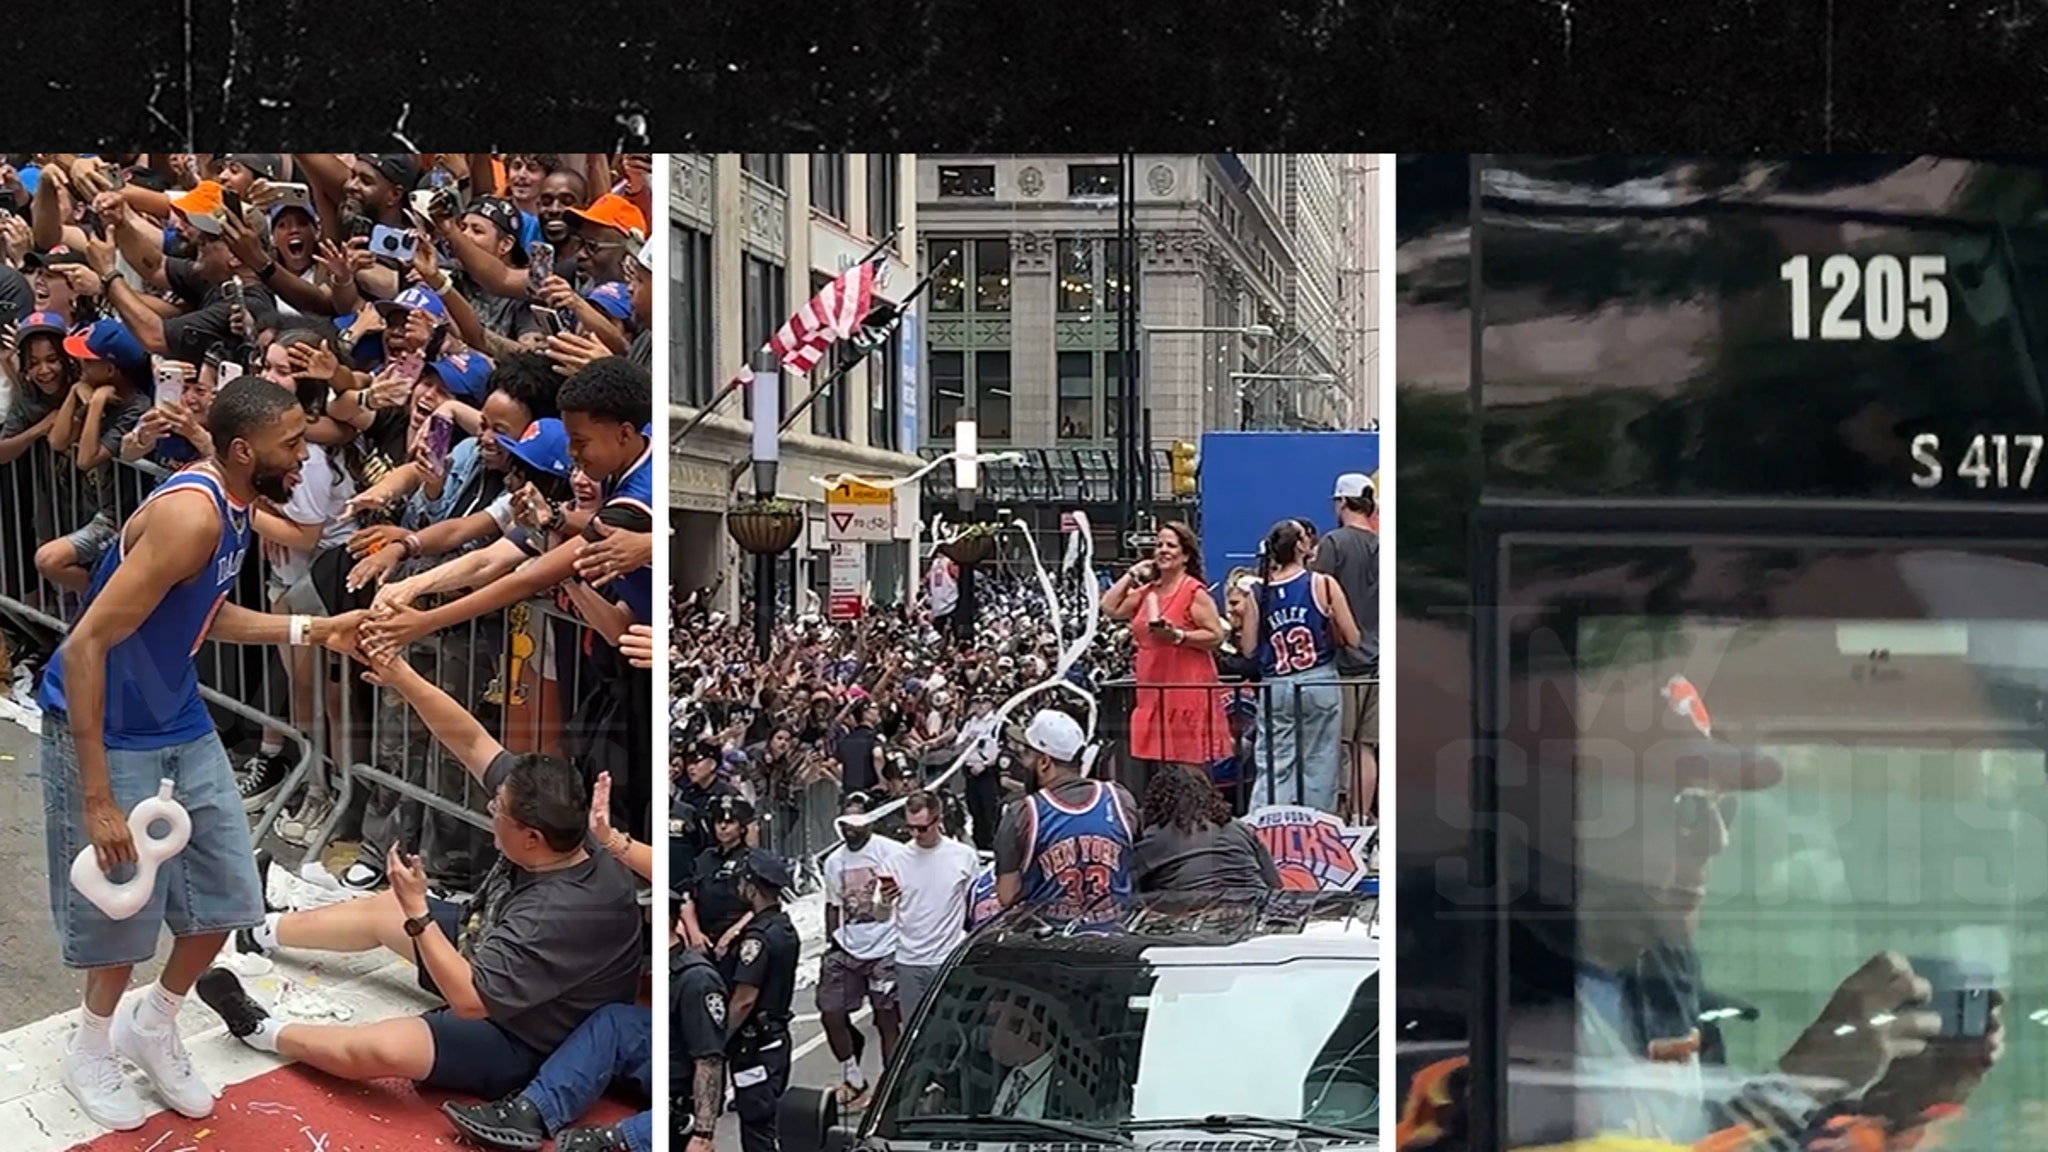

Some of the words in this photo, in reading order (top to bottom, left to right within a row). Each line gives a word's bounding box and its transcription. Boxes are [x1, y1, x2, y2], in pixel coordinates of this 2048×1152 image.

[1780, 254, 1948, 340] 1205
[1911, 433, 1943, 488] S
[1957, 434, 2044, 489] 417
[1270, 626, 1317, 675] 13
[1038, 837, 1076, 881] NEW
[1079, 835, 1122, 871] YORK
[1248, 821, 1358, 880] NICKS
